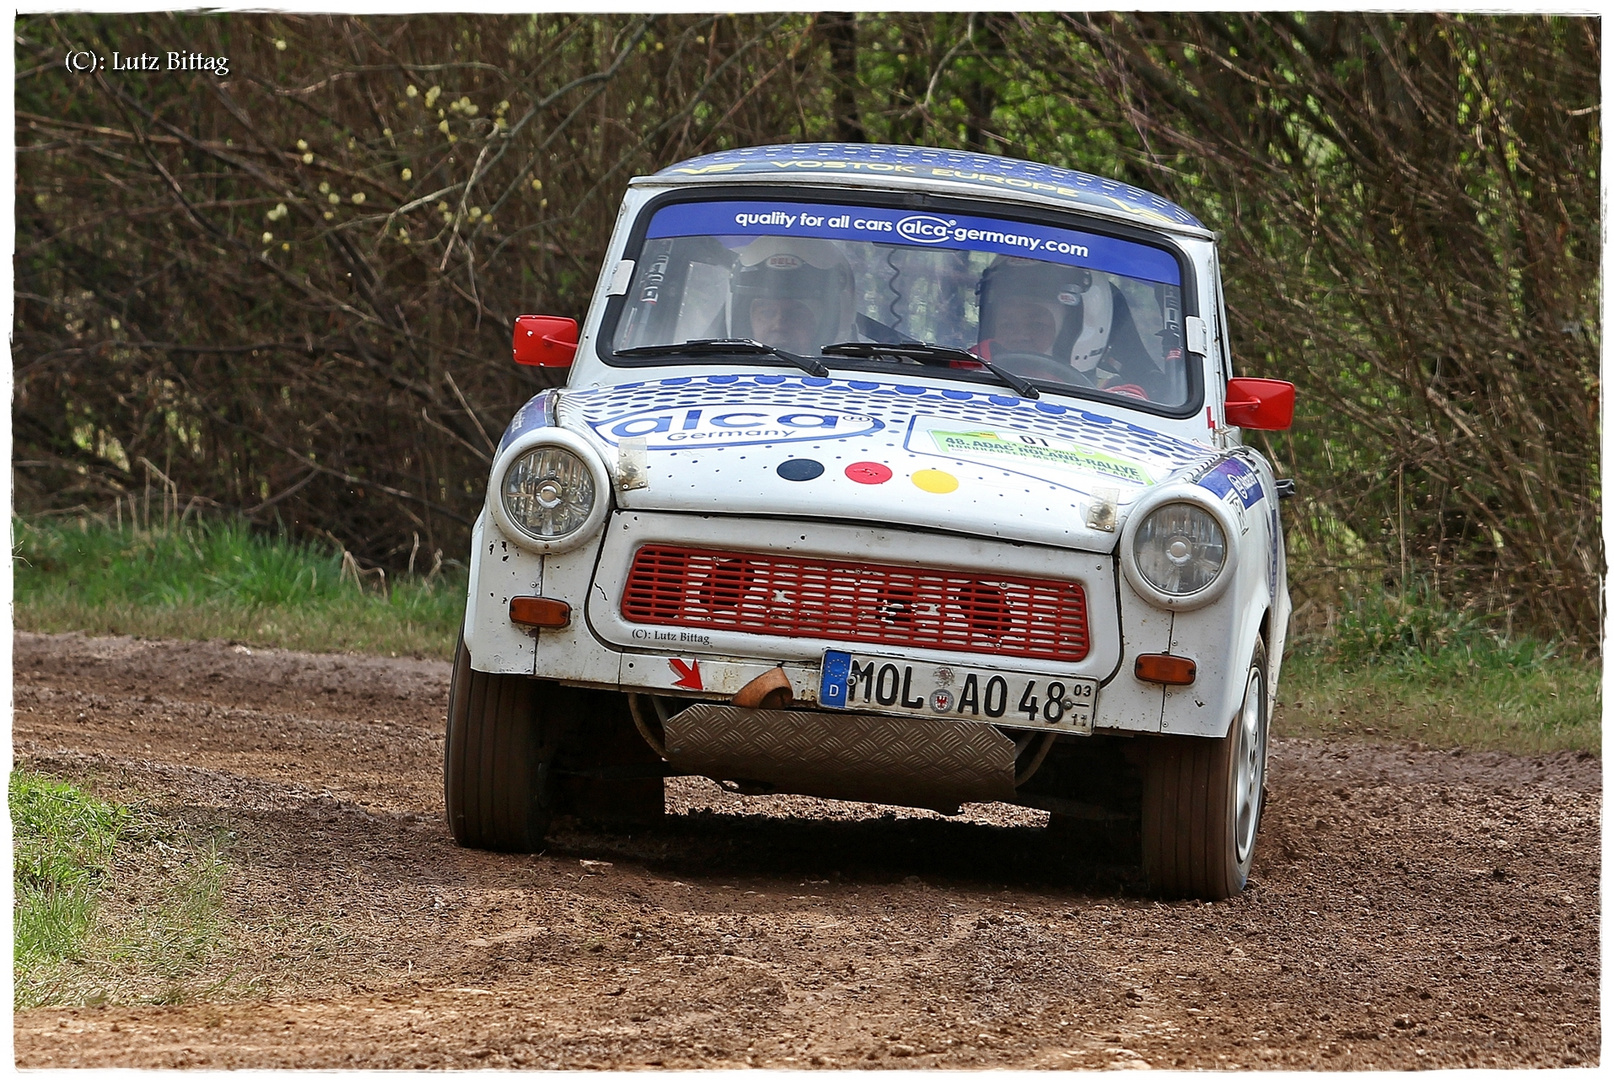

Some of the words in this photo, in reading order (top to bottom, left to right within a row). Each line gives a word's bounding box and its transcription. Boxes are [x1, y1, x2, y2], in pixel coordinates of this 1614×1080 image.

[771, 161, 916, 173] VOSTOK
[932, 168, 1079, 197] EUROPE
[735, 211, 797, 229] quality
[800, 213, 825, 227] for
[828, 215, 850, 229] all
[853, 218, 893, 232] cars
[770, 257, 798, 266] BELL
[611, 410, 839, 437] alca
[667, 429, 796, 441] Germany
[1019, 435, 1050, 448] 01
[945, 436, 971, 447] 48.
[972, 440, 1014, 452] ADAC
[829, 684, 839, 697] D
[848, 659, 924, 709] MOL
[957, 673, 1008, 718] AO
[1018, 680, 1066, 724] 48
[1073, 683, 1092, 697] 03
